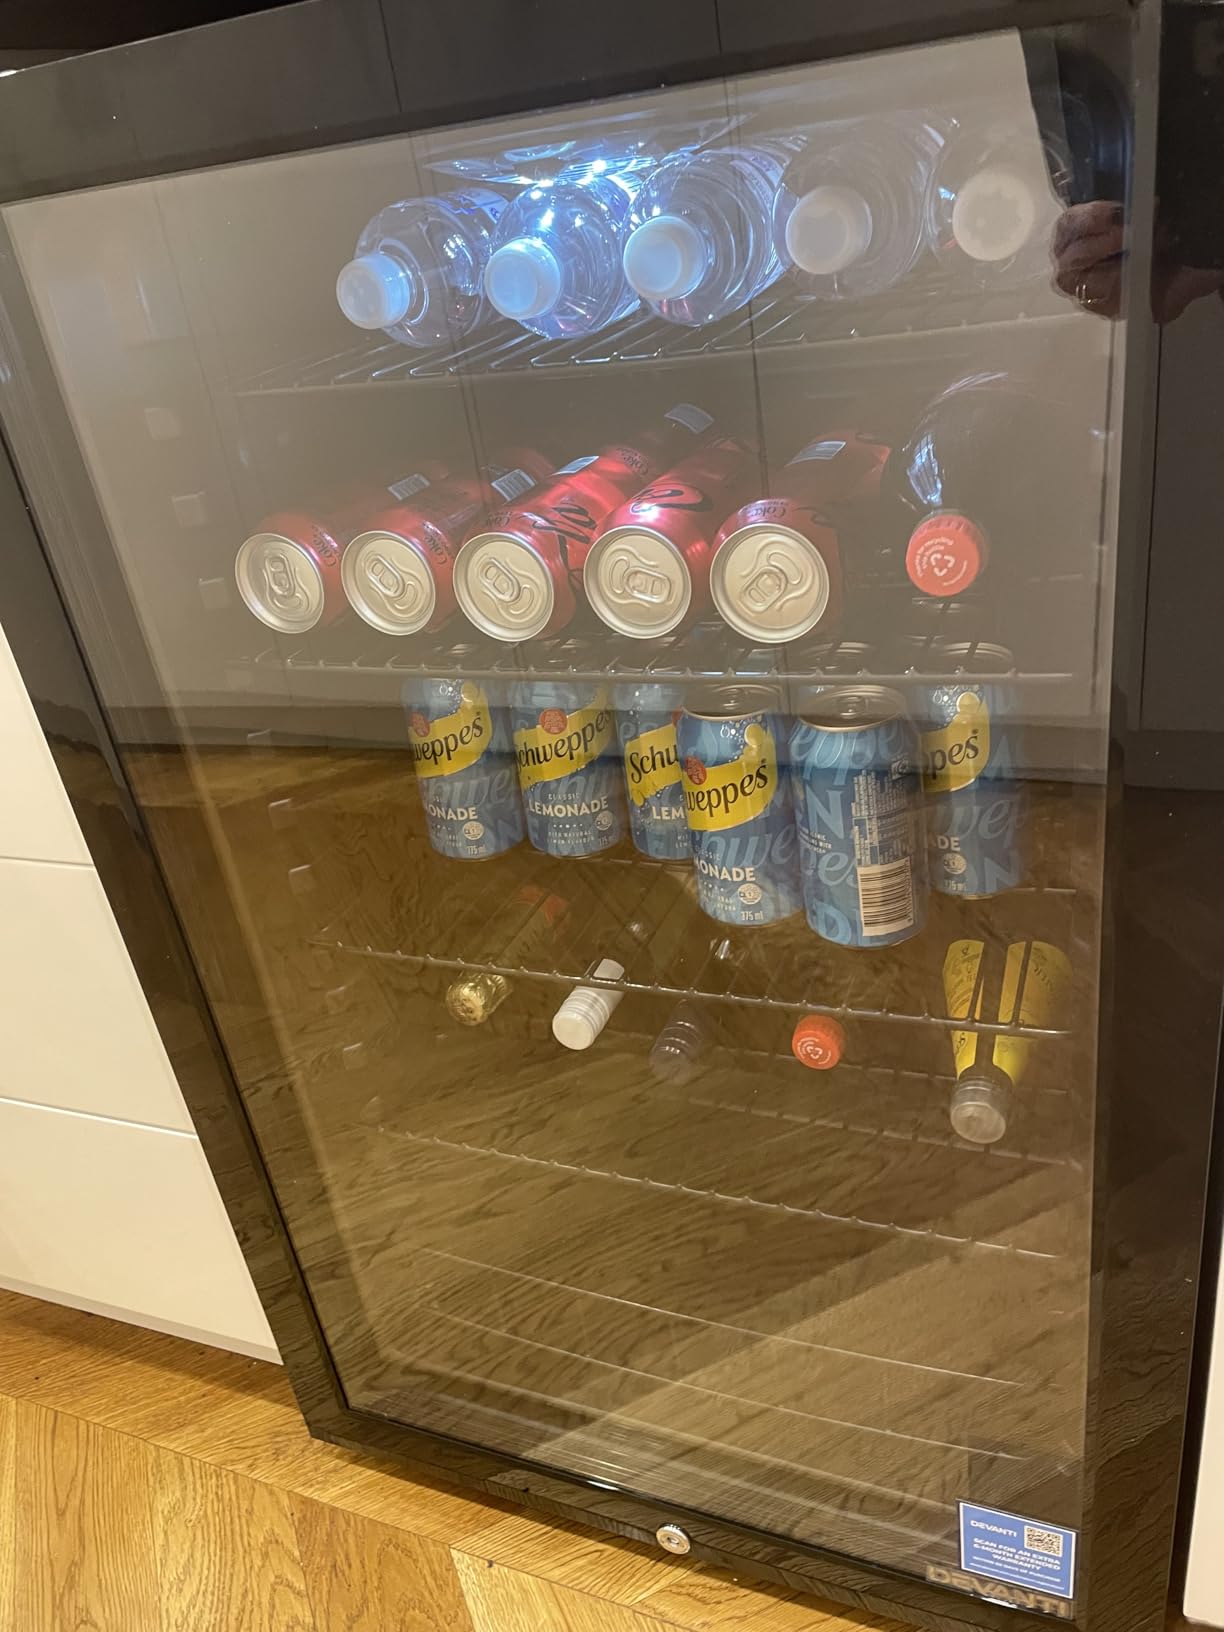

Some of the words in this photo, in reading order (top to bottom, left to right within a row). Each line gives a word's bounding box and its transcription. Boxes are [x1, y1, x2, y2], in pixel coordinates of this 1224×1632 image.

[424, 805, 478, 821] ONADE
[528, 795, 609, 818] LEMONADE
[969, 1519, 1018, 1538] DEVANTI
[973, 1537, 997, 1548] SCAN
[998, 1543, 1017, 1553] FOR
[1032, 1553, 1061, 1565] EXTRA
[991, 1554, 1041, 1571] WARRANTY
[1014, 1554, 1061, 1570] EXTENDED
[926, 1565, 1070, 1617] DEVANTI
